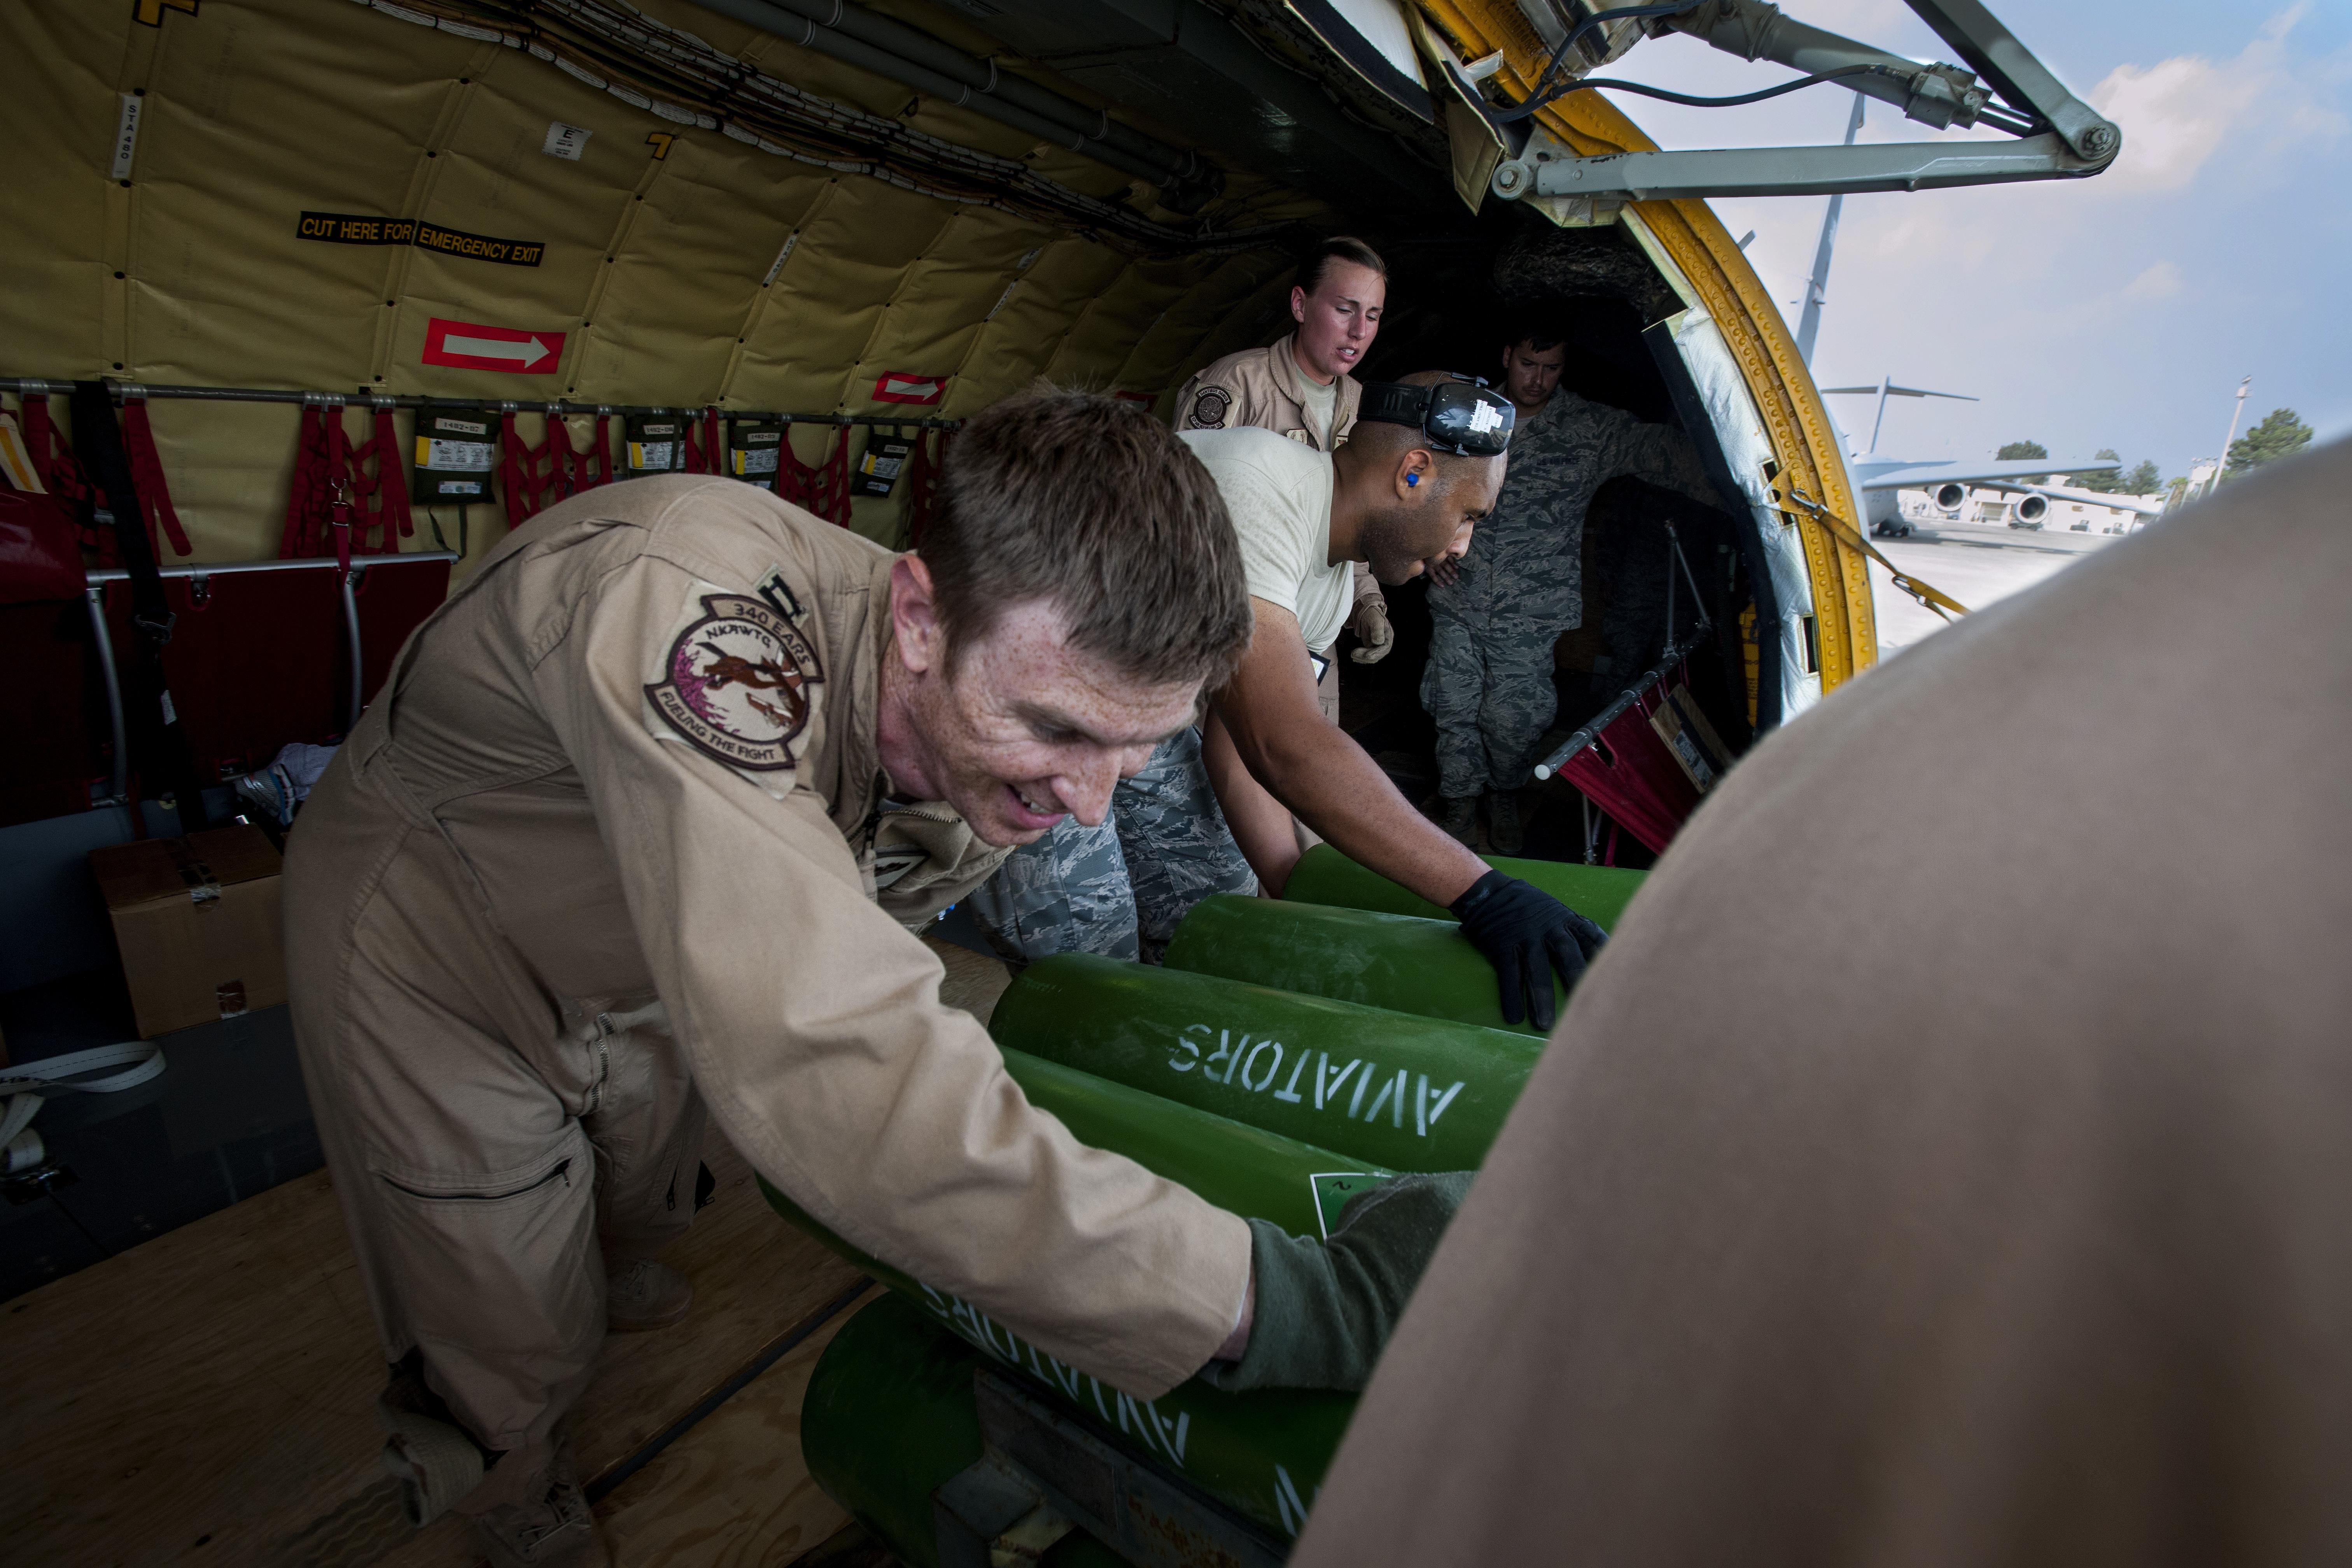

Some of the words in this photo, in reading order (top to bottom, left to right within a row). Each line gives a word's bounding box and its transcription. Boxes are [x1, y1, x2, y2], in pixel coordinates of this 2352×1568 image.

[125, 104, 137, 131] STA
[563, 129, 575, 139] E
[120, 136, 132, 159] 480
[301, 218, 337, 237] CUT
[340, 222, 380, 240] HERE
[383, 223, 413, 240] FOR
[419, 228, 510, 260] EMERGENCY
[511, 245, 541, 263] EXIT
[734, 603, 769, 624] 340
[772, 621, 810, 665] EARS
[660, 691, 707, 737] FUELING
[709, 734, 735, 753] THE
[738, 743, 775, 760] FIGHT
[1168, 1024, 1465, 1137] AVIATORS
